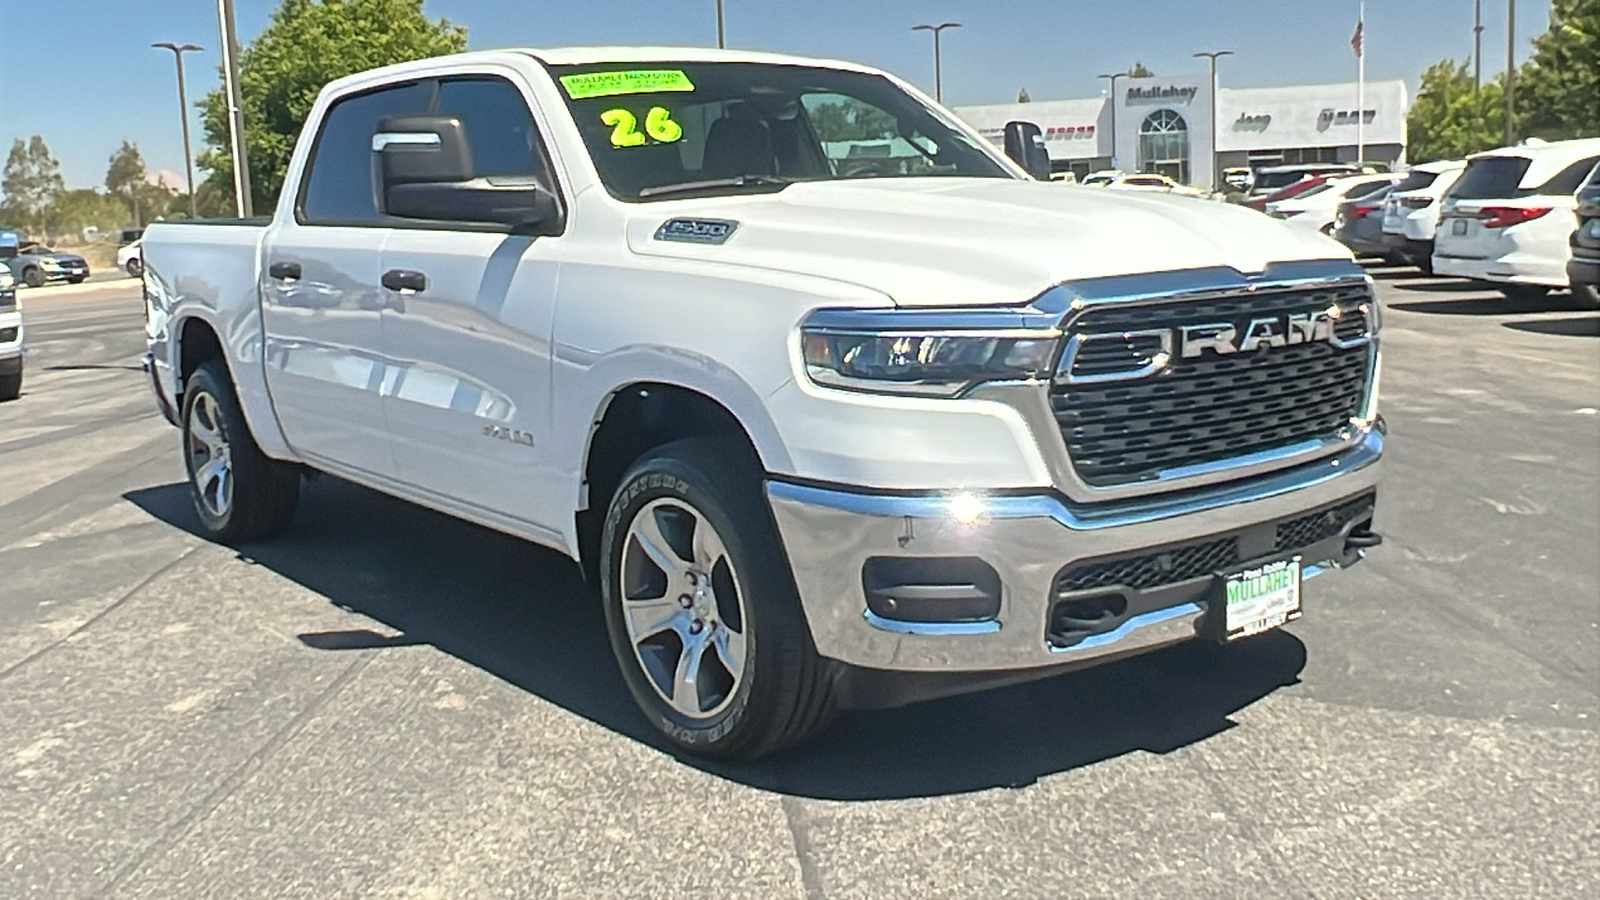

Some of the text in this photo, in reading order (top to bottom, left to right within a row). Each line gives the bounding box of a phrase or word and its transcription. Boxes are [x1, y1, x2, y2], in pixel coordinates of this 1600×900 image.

[1128, 85, 1198, 103] Mullahey
[600, 106, 682, 146] 26
[1178, 312, 1335, 358] RAM
[1228, 567, 1295, 604] MULLAHEY
